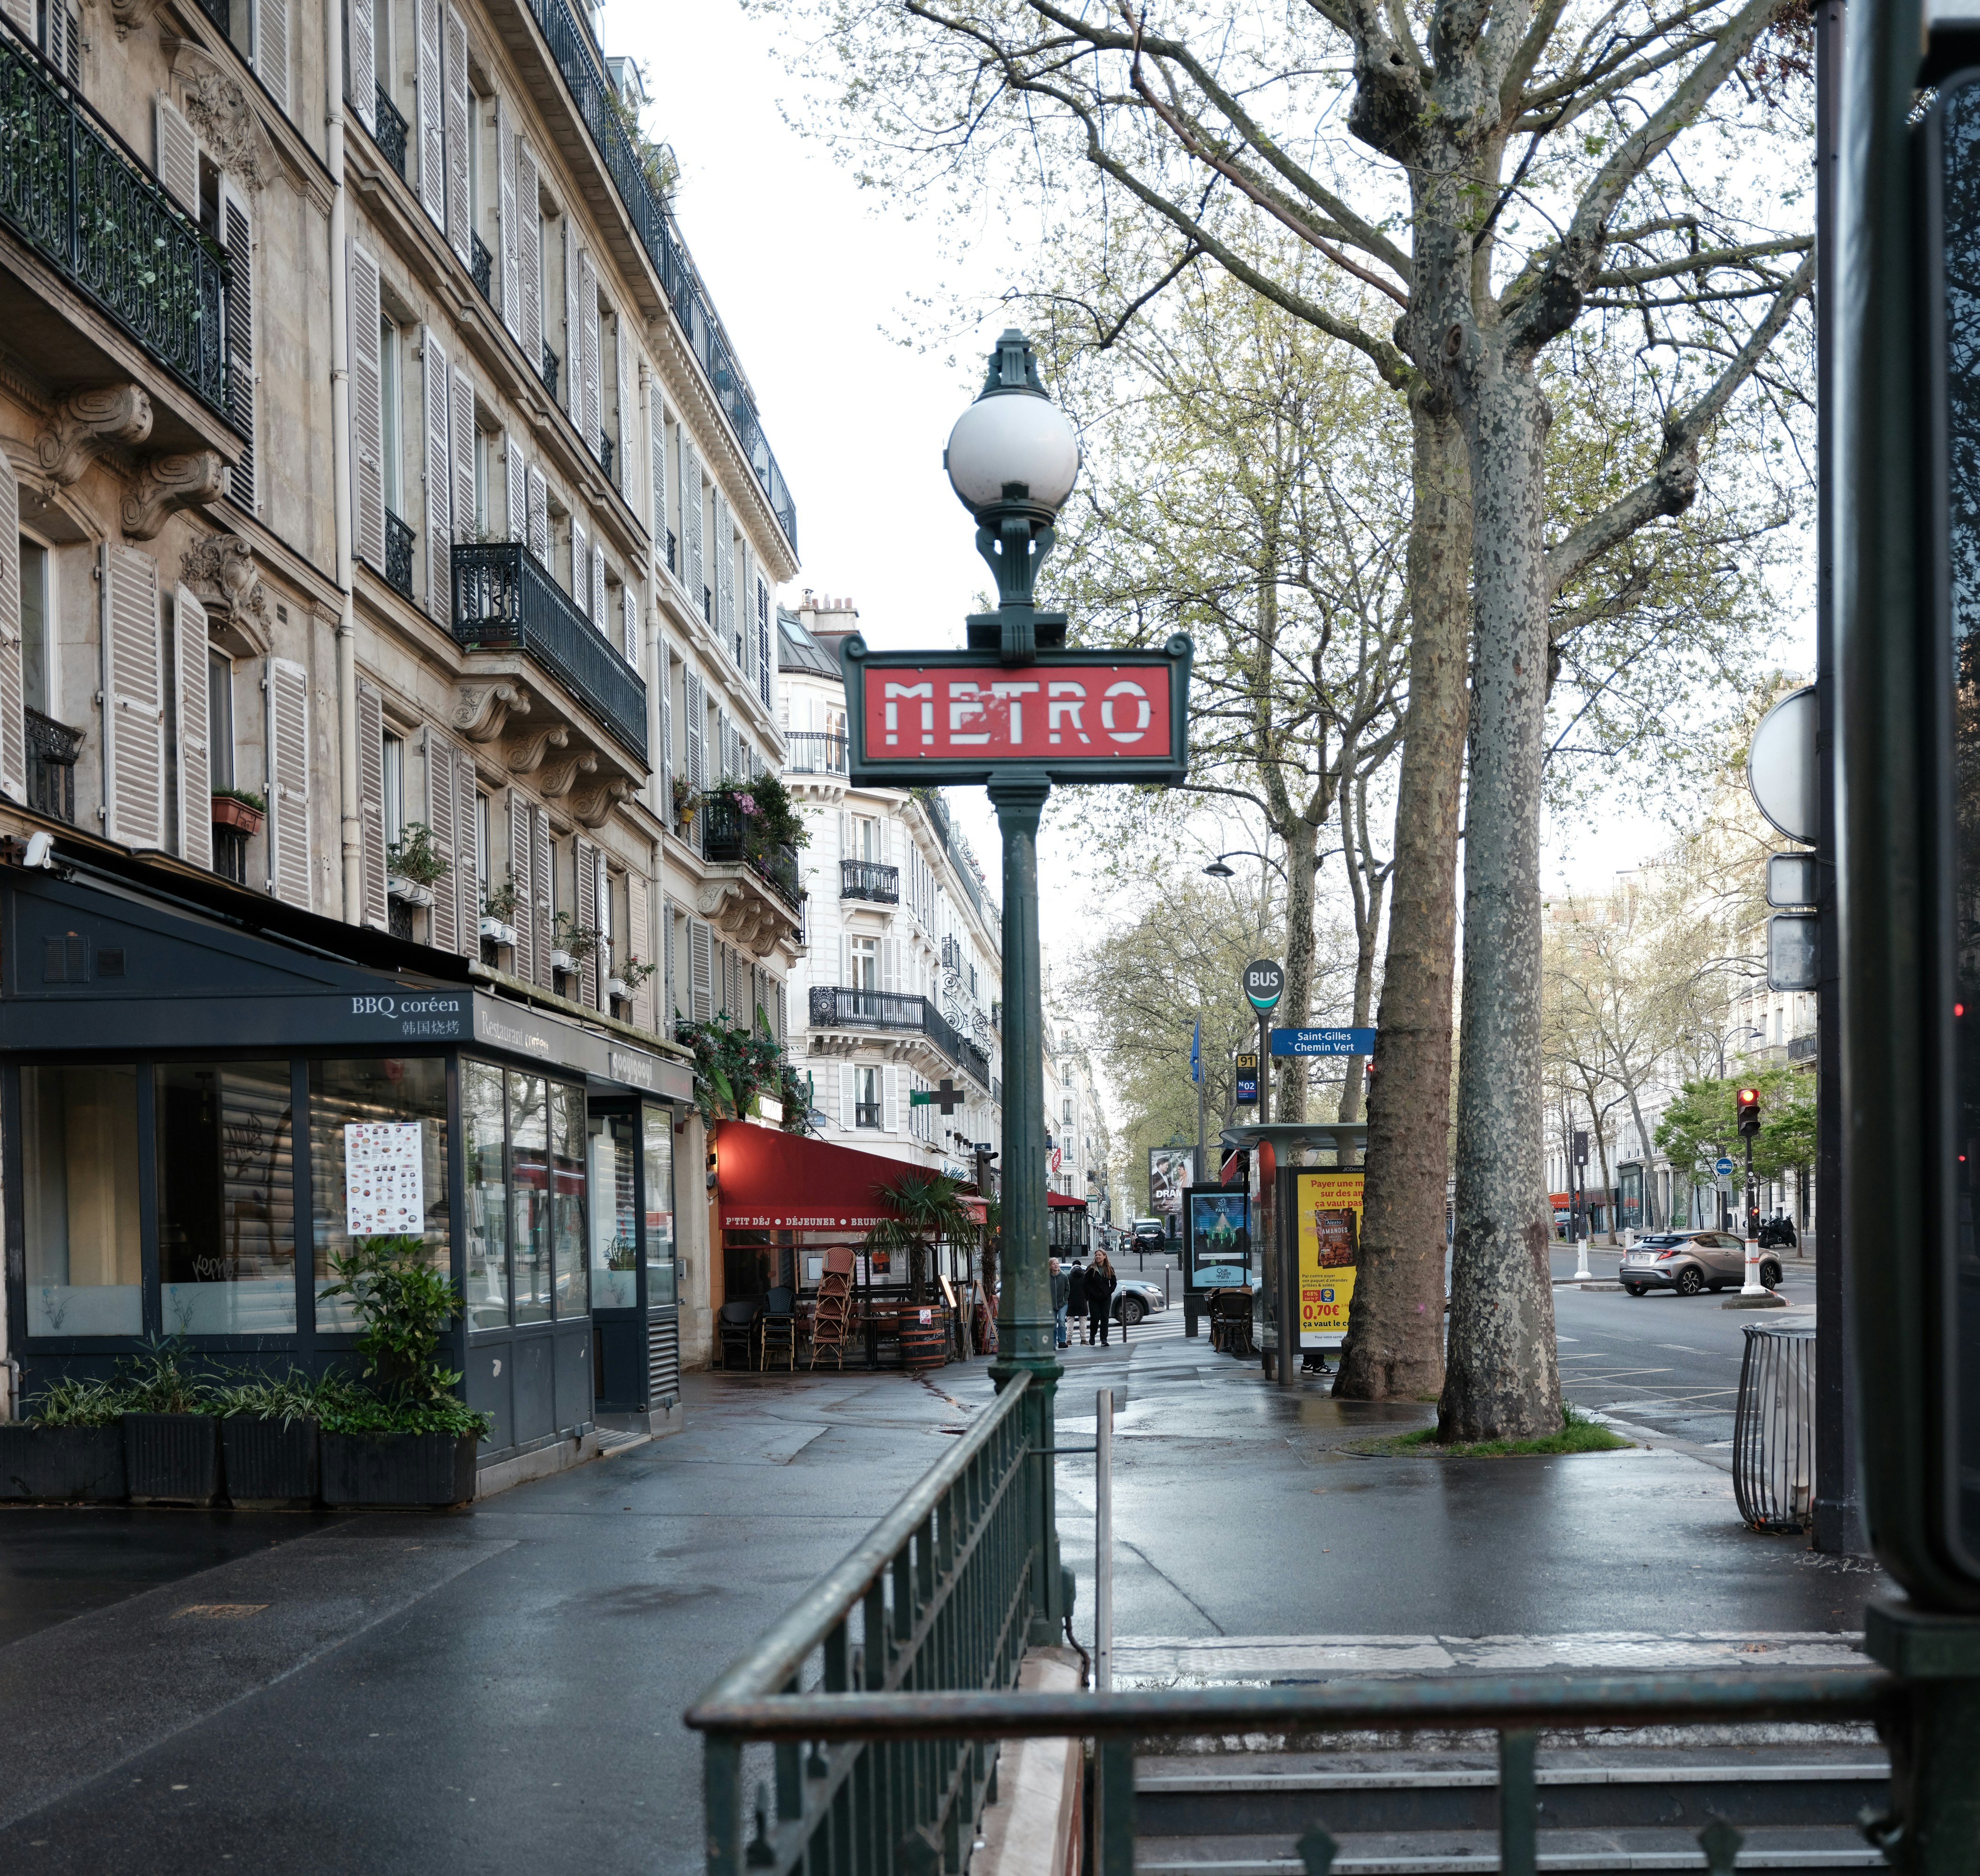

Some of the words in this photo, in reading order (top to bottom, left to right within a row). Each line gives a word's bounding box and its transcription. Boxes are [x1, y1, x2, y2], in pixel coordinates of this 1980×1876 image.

[884, 680, 1151, 745] METRO
[1250, 972, 1278, 986] BUS
[351, 996, 399, 1018] BBQ
[401, 997, 460, 1013] coréen
[402, 1020, 460, 1035] 韩国烧烤
[481, 1010, 523, 1046] Restaurant
[525, 1032, 549, 1054] coréen
[1298, 1032, 1351, 1041] Saint-Gilles
[1294, 1043, 1330, 1051] Chemin
[1333, 1043, 1354, 1051] Vert
[1240, 1057, 1253, 1066] 91
[612, 1051, 652, 1087] gooyigooyi
[1311, 1180, 1335, 1189] Payer
[753, 1216, 770, 1225] DÉJ
[786, 1216, 835, 1225] DÉJEUNER
[1303, 1304, 1340, 1320] 0.70€
